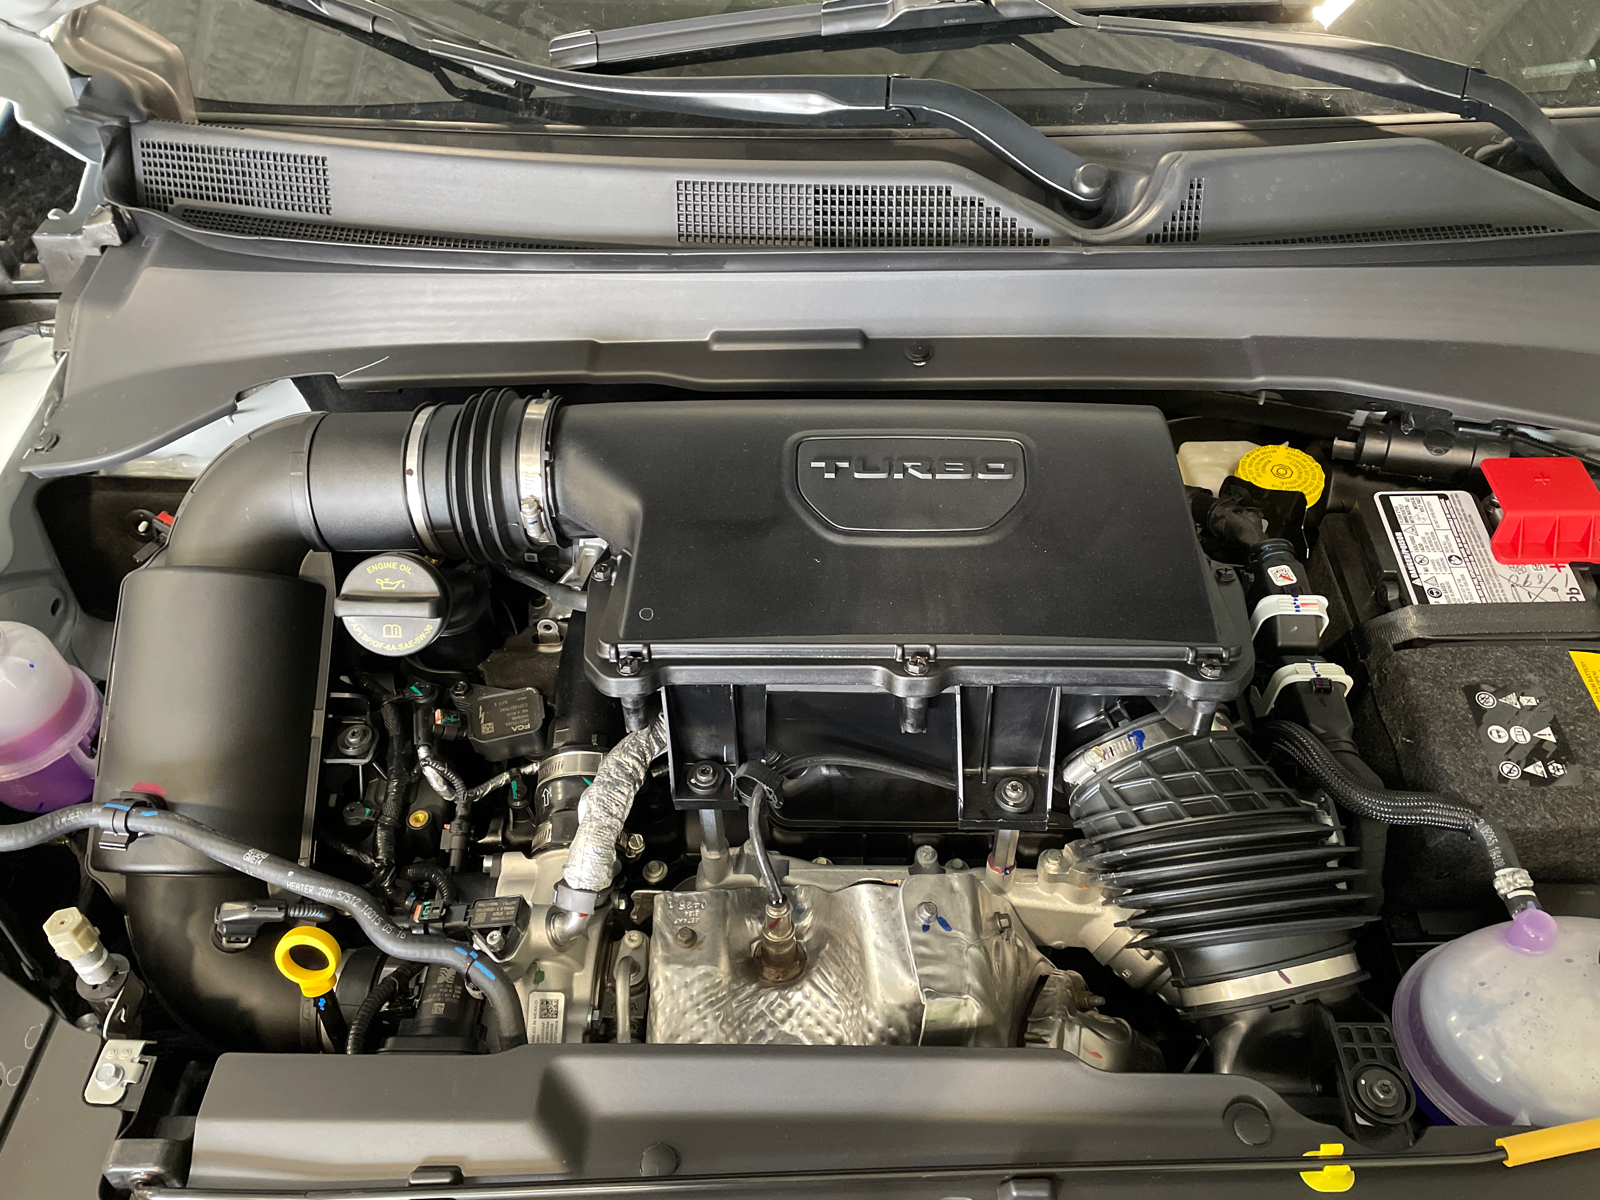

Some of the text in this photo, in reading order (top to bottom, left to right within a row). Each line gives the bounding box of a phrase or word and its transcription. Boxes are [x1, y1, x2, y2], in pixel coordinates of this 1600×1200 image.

[810, 458, 1015, 479] TURBO
[366, 562, 412, 575] ENGINE OIL
[350, 623, 363, 636] API
[1580, 661, 1594, 683] BATTERY
[511, 723, 530, 731] FCA
[286, 881, 314, 895] HEATER
[318, 887, 334, 898] 7MM
[335, 890, 362, 908] 57512
[360, 904, 383, 926] 10015
